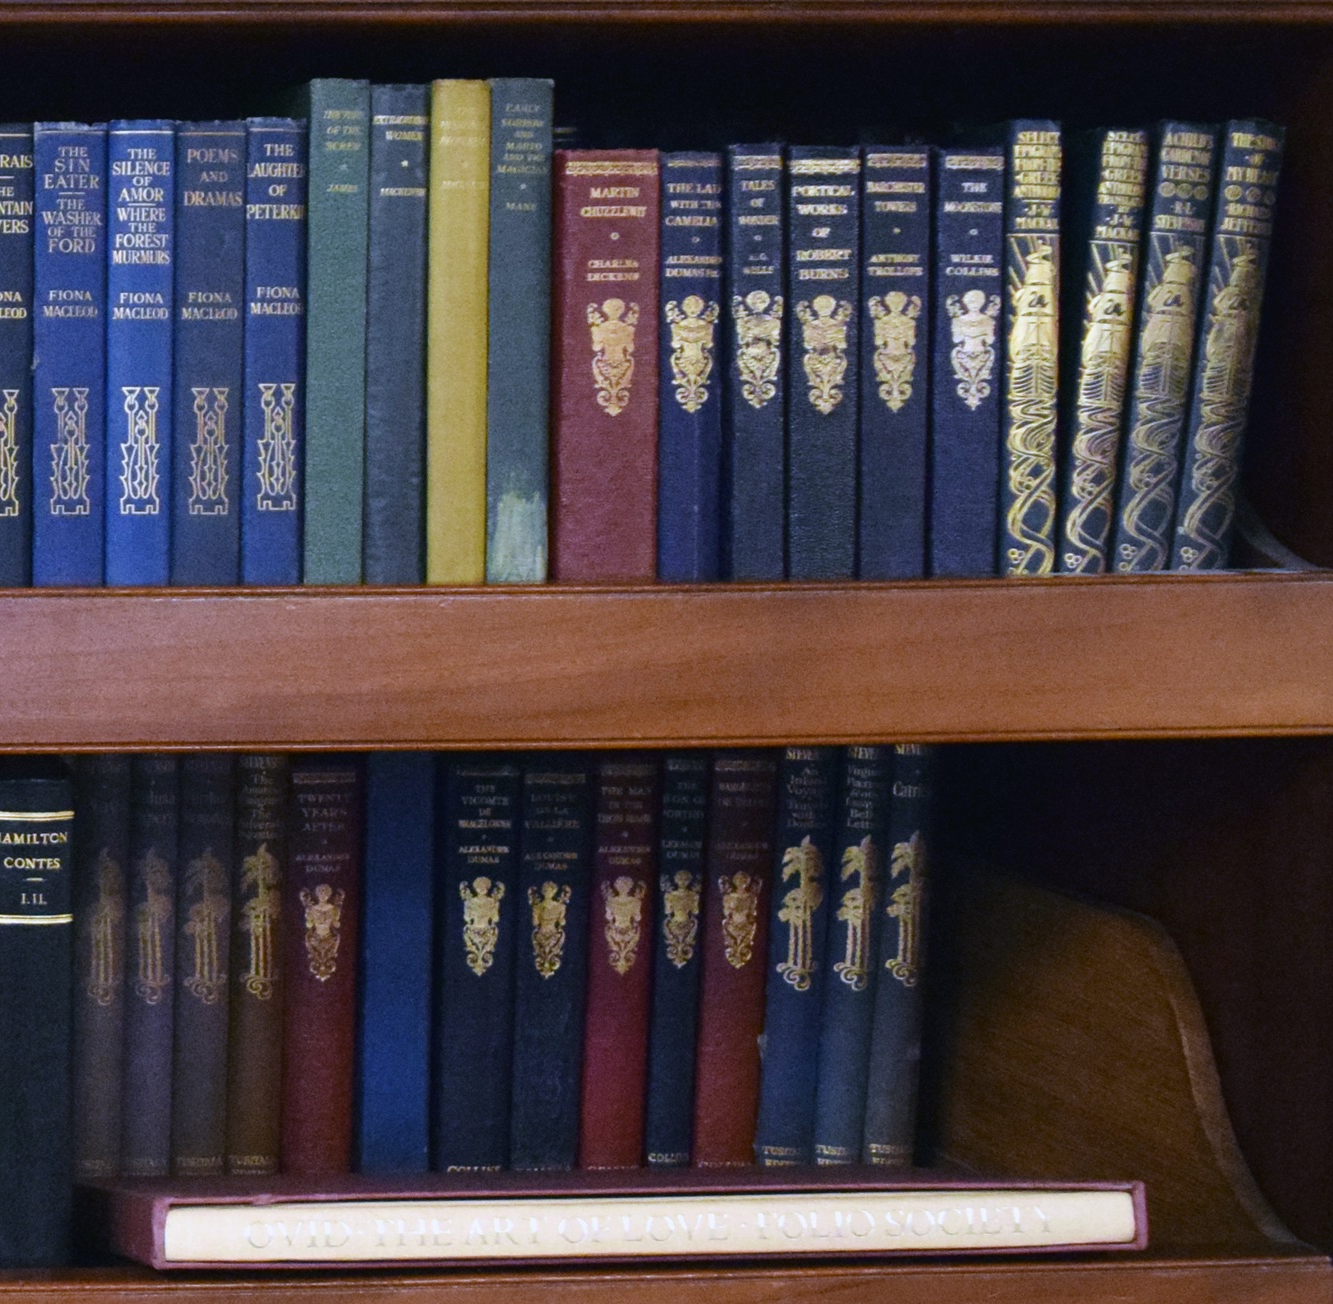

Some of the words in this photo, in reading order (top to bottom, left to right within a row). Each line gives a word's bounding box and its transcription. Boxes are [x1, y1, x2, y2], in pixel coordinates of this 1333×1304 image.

[58, 147, 88, 157] THE
[128, 149, 156, 160] THE
[263, 144, 294, 157] THE
[54, 159, 90, 172] SIN
[112, 161, 170, 176] SILENCE
[44, 174, 99, 189] EATER
[133, 176, 153, 187] OF
[199, 171, 228, 182] AND
[268, 184, 287, 197] OF
[590, 187, 640, 199] MARTIN
[961, 182, 988, 193] THE
[118, 187, 164, 202] AMOR
[183, 191, 243, 207] DRAMAS
[57, 199, 85, 210] THE
[42, 211, 103, 226] WASHER
[117, 208, 166, 222] WHERE
[48, 227, 64, 237] OF
[72, 227, 96, 237] THE
[128, 222, 156, 233] THE
[48, 239, 96, 253] FORD
[115, 234, 169, 249] FOREST
[112, 250, 170, 265] MURMURS
[49, 290, 93, 301] FIONA
[119, 292, 164, 304] FIONA
[3, 857, 61, 870] CONTES
[246, 1220, 350, 1250] OVID
[372, 1217, 453, 1247] THE
[464, 1217, 548, 1246] ART
[558, 1214, 618, 1244] OF
[622, 1212, 728, 1242] LOVE
[758, 1209, 874, 1239] FOLIO
[884, 1205, 1055, 1237] SOCIETY
